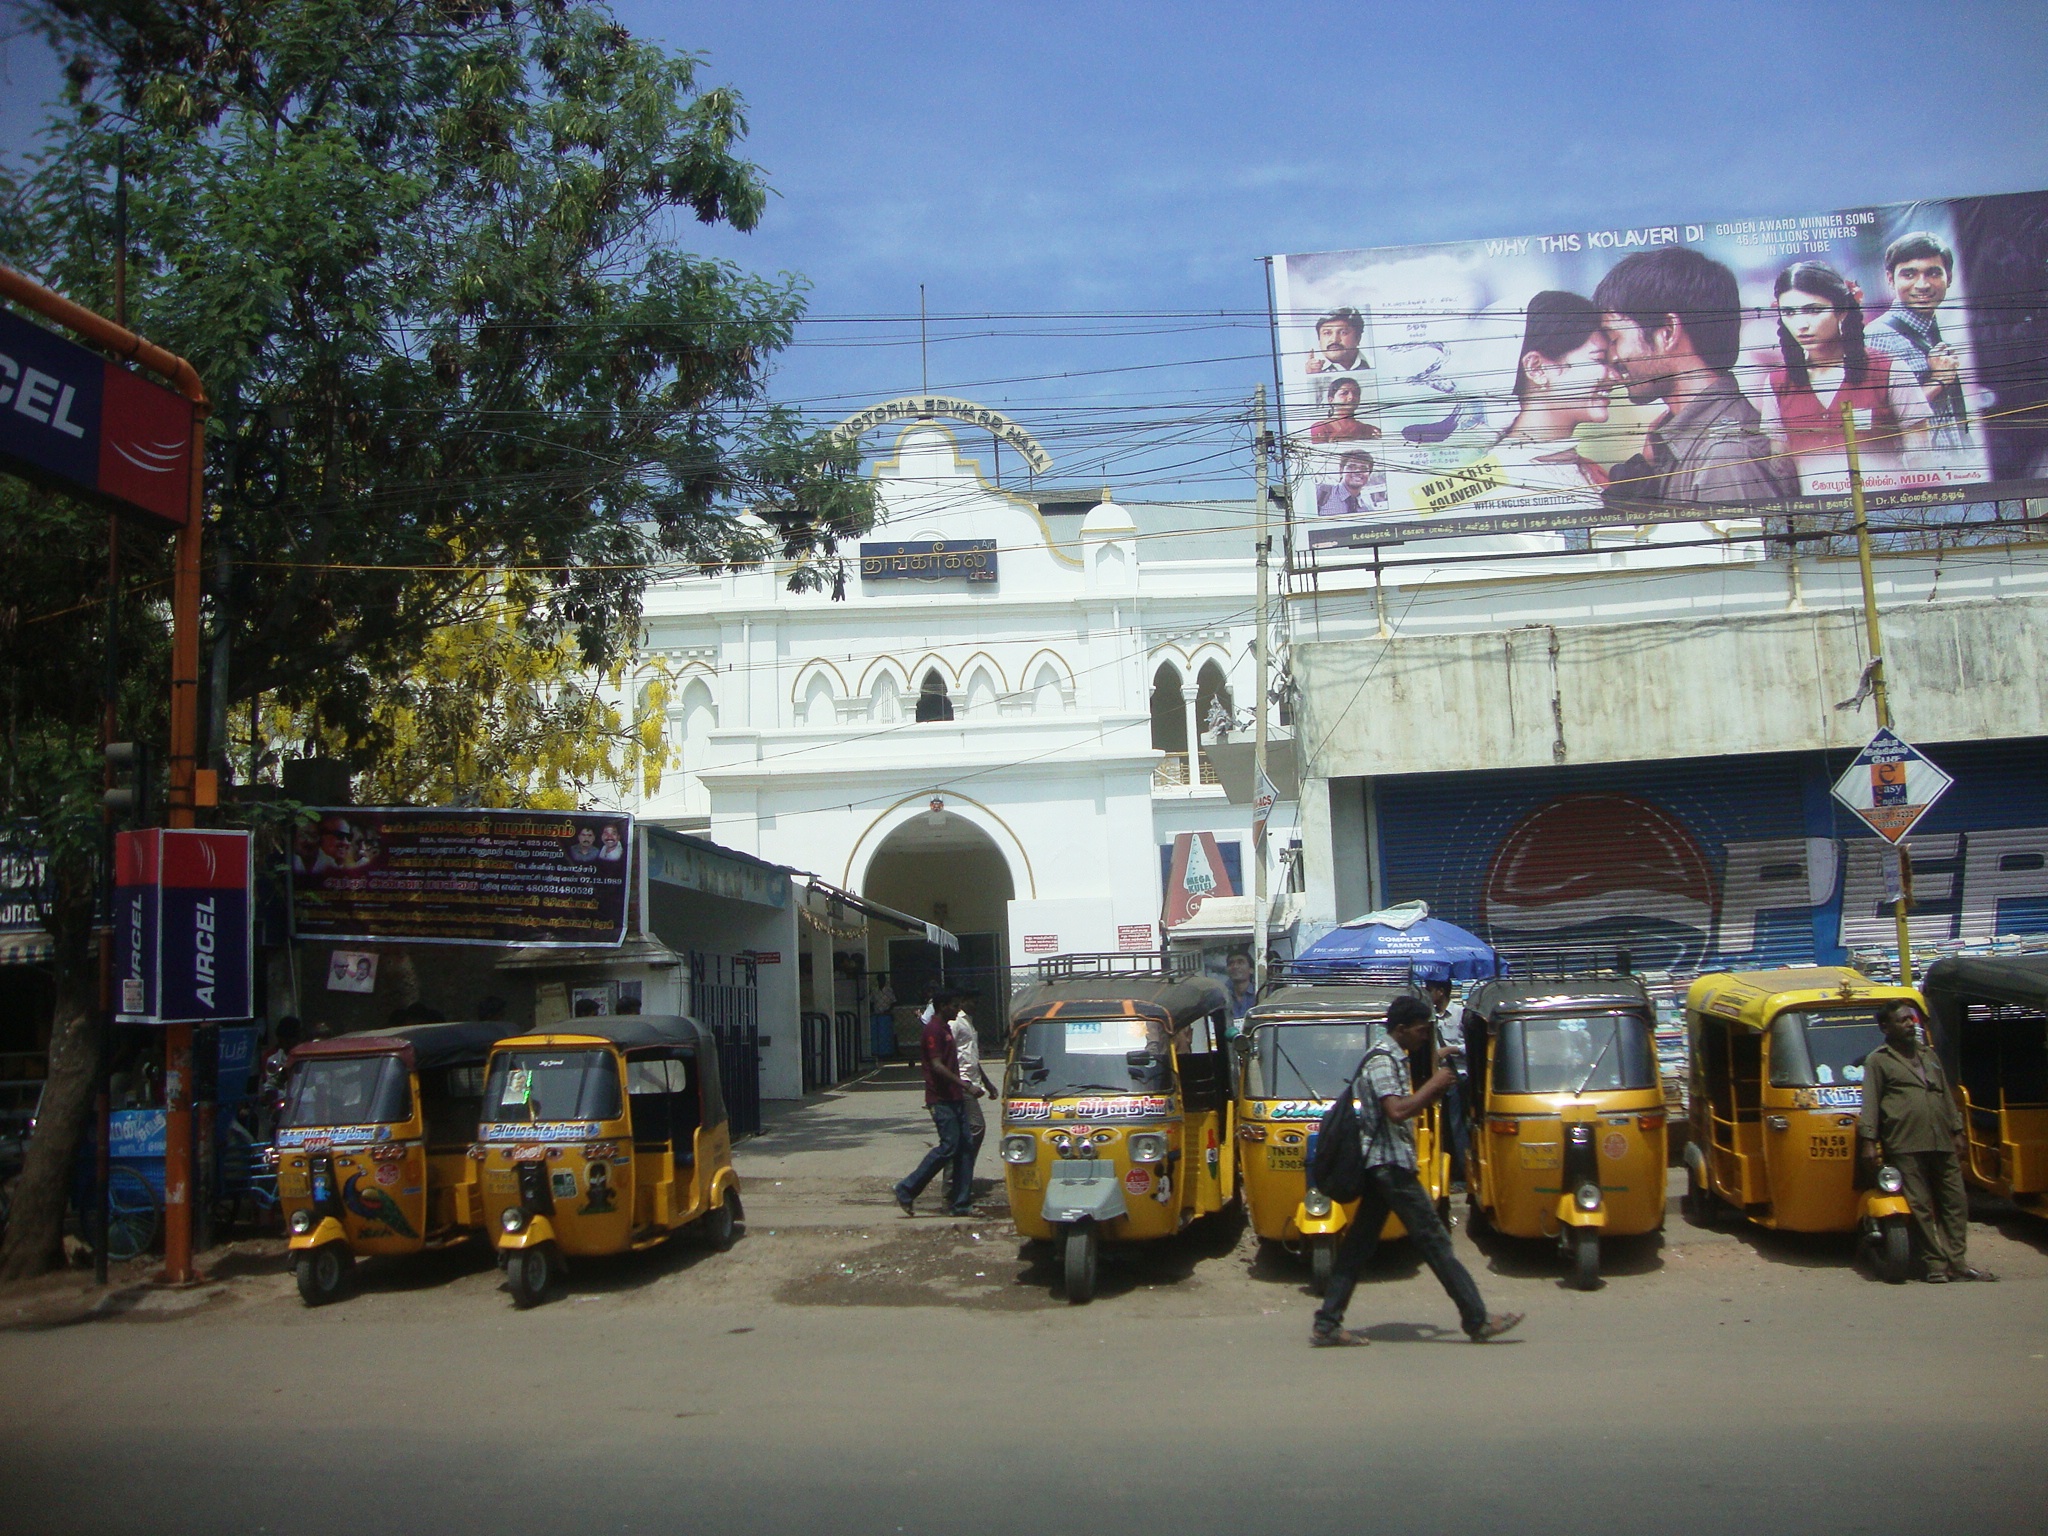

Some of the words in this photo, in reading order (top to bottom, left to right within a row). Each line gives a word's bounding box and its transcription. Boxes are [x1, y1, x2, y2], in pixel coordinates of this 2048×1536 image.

[1716, 224, 1756, 236] GOLDEN
[1759, 218, 1796, 231] AWARD
[1846, 212, 1875, 225] SONG
[1485, 238, 1529, 257] WHY
[1537, 233, 1581, 253] THIS
[1588, 226, 1678, 249] KOLAVERI
[1686, 224, 1704, 243] DI
[1762, 230, 1809, 244] MILLIONS
[1813, 226, 1857, 240] VIEWERS
[1767, 245, 1777, 256] IN
[1780, 242, 1800, 255] YOU
[1803, 241, 1831, 253] TUBE
[835, 399, 918, 441] VICTORIA
[924, 399, 1004, 430] EDWARD
[1422, 476, 1454, 498] Why
[1457, 462, 1493, 482] This
[1811, 477, 1851, 493] கோபுரம்
[1900, 472, 1940, 484] MIDIA
[1429, 483, 1482, 512] KOLAVERI
[1474, 500, 1495, 511] WITH
[1498, 499, 1531, 510] ENGLISH
[1532, 495, 1576, 507] SUBTITLES
[1581, 515, 1598, 524] CAS
[1600, 513, 1622, 522] MPSE
[494, 818, 576, 838] படிப்பகம்
[532, 848, 565, 859] மன்றம்
[1186, 874, 1211, 886] MEGA
[1188, 882, 1212, 893] KULFI
[526, 884, 594, 895] 480521480526
[131, 893, 143, 982] IRCEL
[196, 896, 215, 1010] AIRCEL
[1375, 948, 1435, 956] NEWSPAPER
[1657, 999, 1676, 1008] MBA
[1811, 1136, 1828, 1146] TN
[1272, 1146, 1285, 1156] TN
[1286, 1146, 1299, 1156] 58
